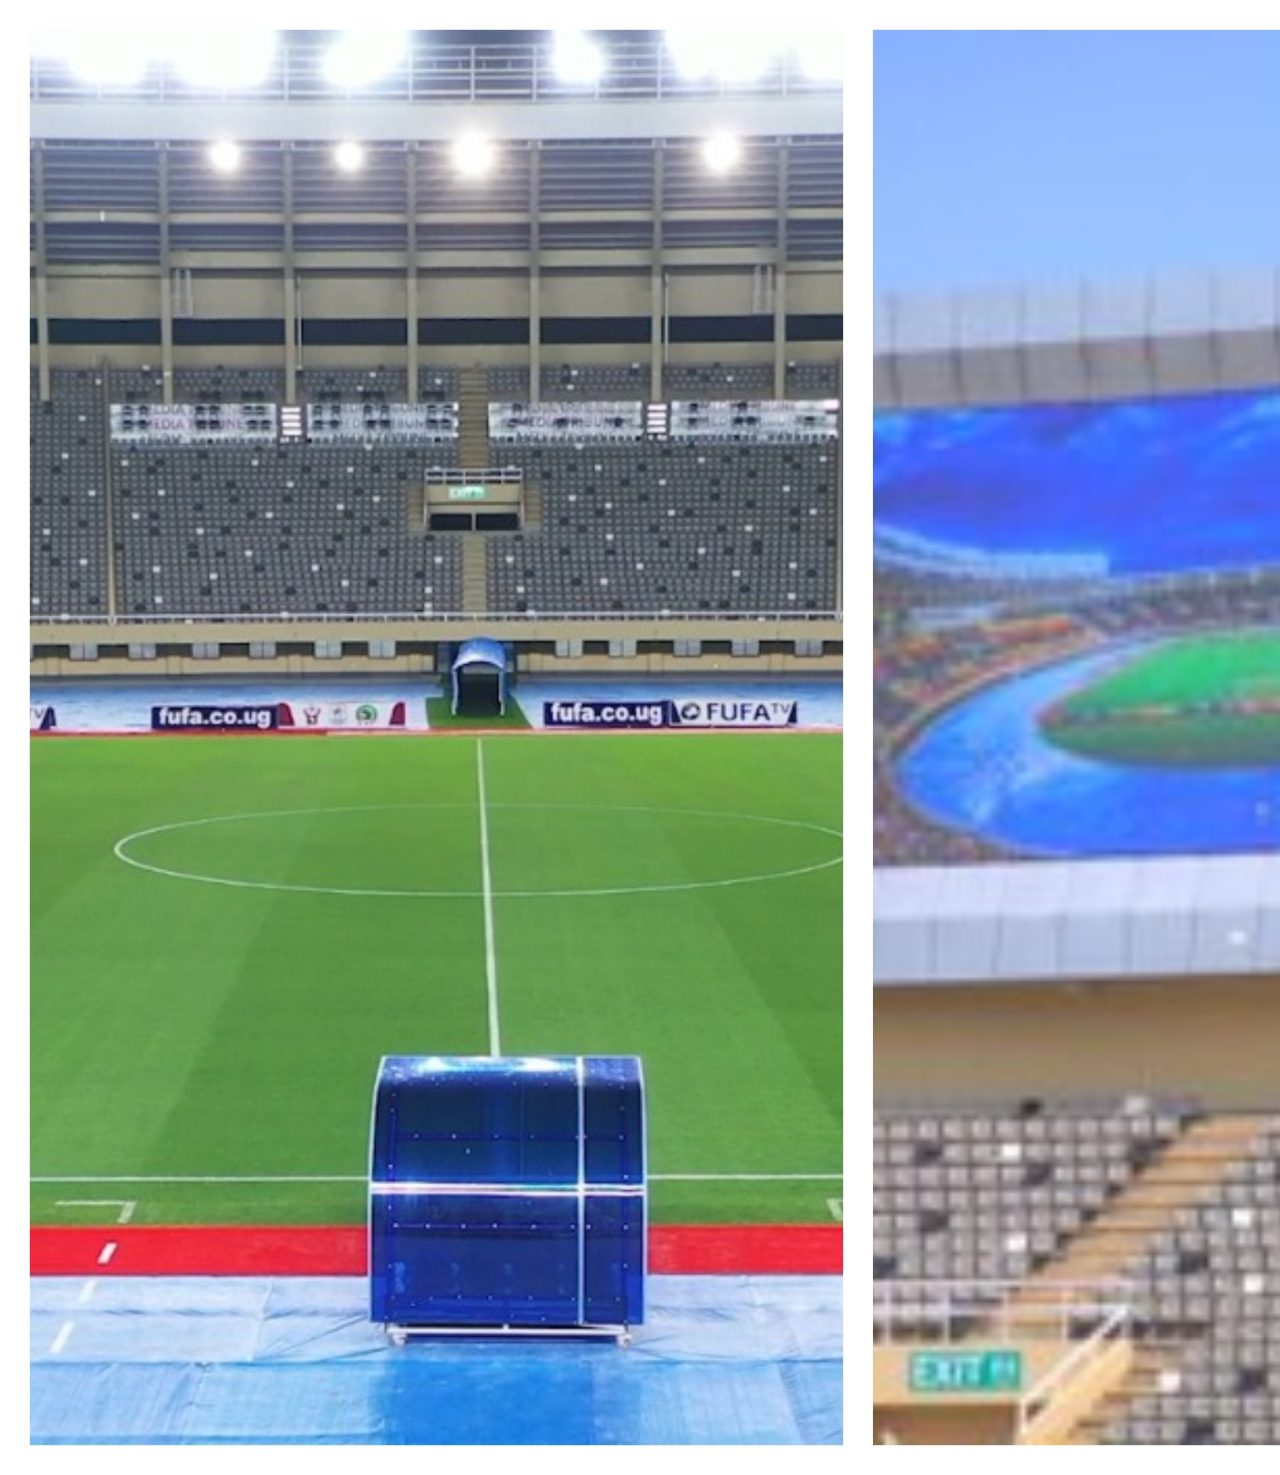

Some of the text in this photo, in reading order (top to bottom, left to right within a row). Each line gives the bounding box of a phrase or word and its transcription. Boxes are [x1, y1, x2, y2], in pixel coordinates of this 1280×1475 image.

[159, 706, 272, 729] fufa.co.ug
[551, 703, 662, 726] fufa.co.ug
[914, 1355, 980, 1387] EXIT
